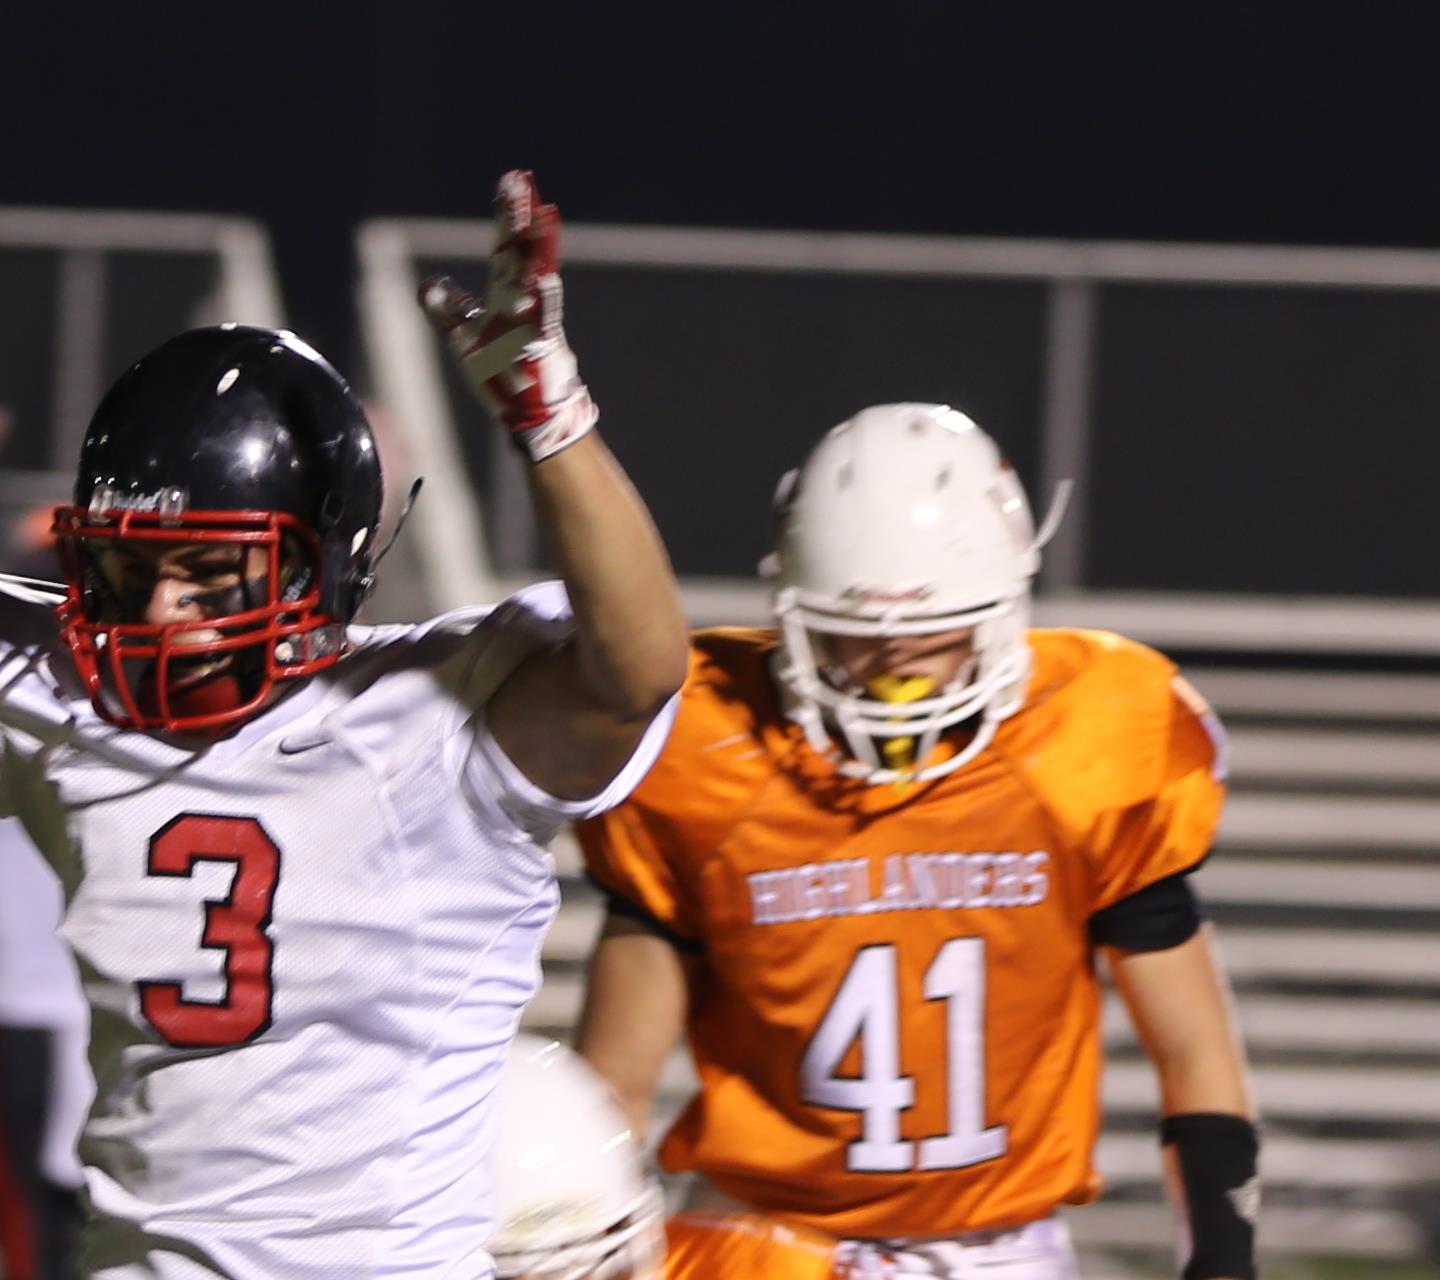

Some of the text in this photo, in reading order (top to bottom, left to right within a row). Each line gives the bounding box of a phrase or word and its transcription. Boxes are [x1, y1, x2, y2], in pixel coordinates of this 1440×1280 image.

[135, 811, 281, 1047] 3
[747, 850, 1050, 926] HIGHLANDERS
[799, 936, 1009, 1172] 41
